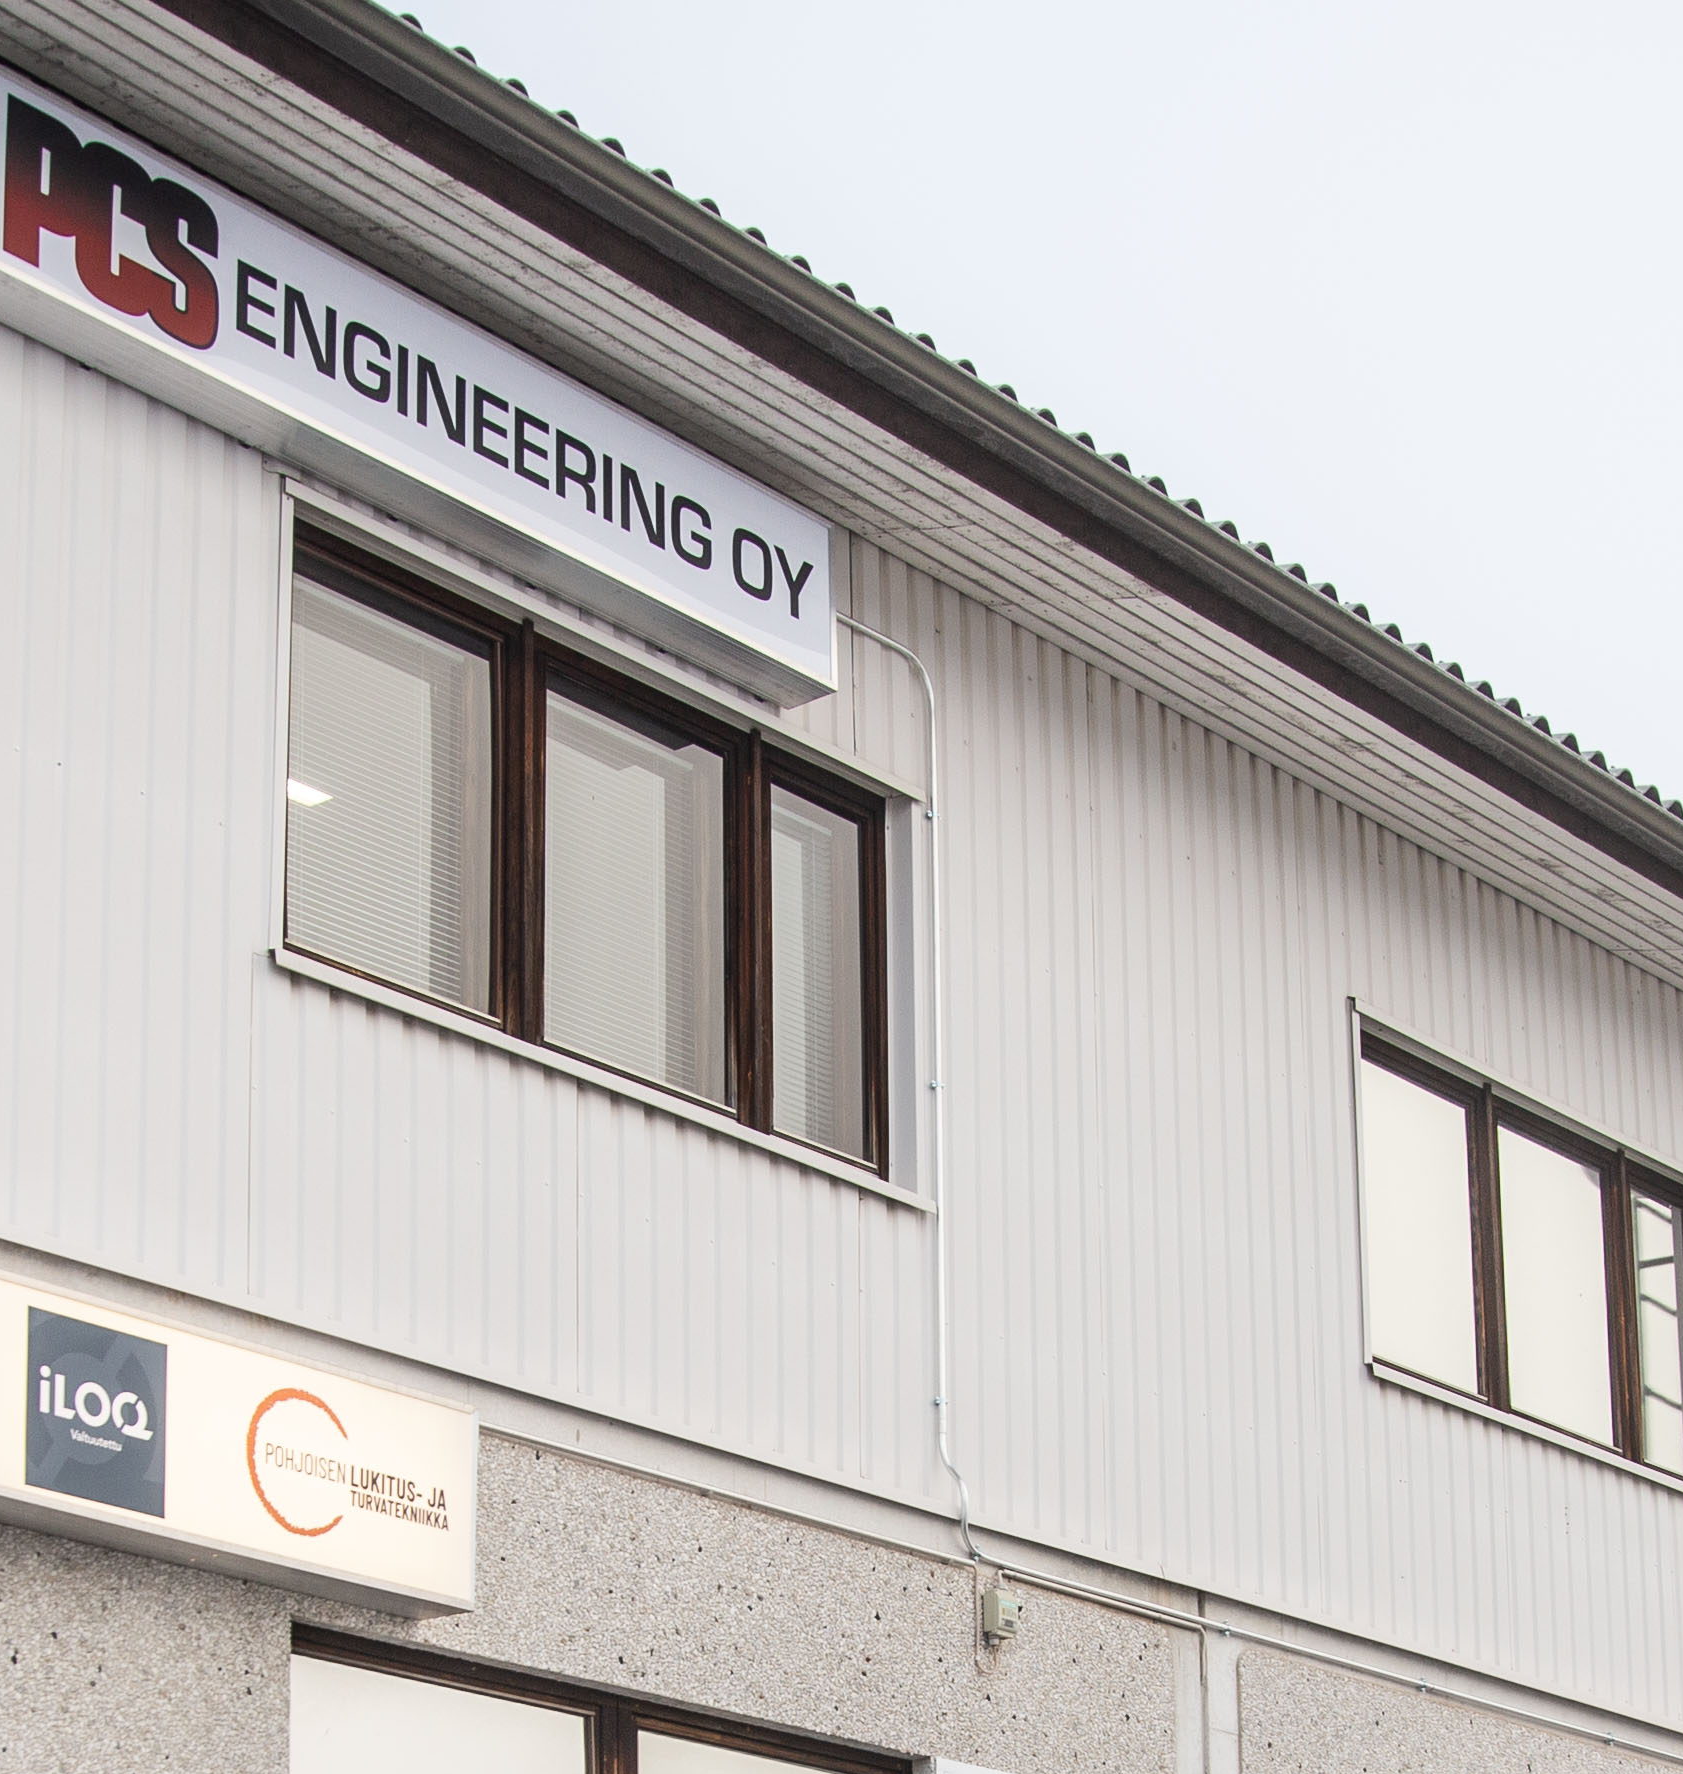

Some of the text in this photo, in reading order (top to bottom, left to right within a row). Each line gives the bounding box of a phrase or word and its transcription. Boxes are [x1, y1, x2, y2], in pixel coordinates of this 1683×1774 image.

[2, 94, 814, 620] PCS ENGINEERING OY
[265, 1442, 447, 1511] POHJOISEN LUKITUS- JA
[350, 1489, 450, 1532] TURVATEKNIIKKA
